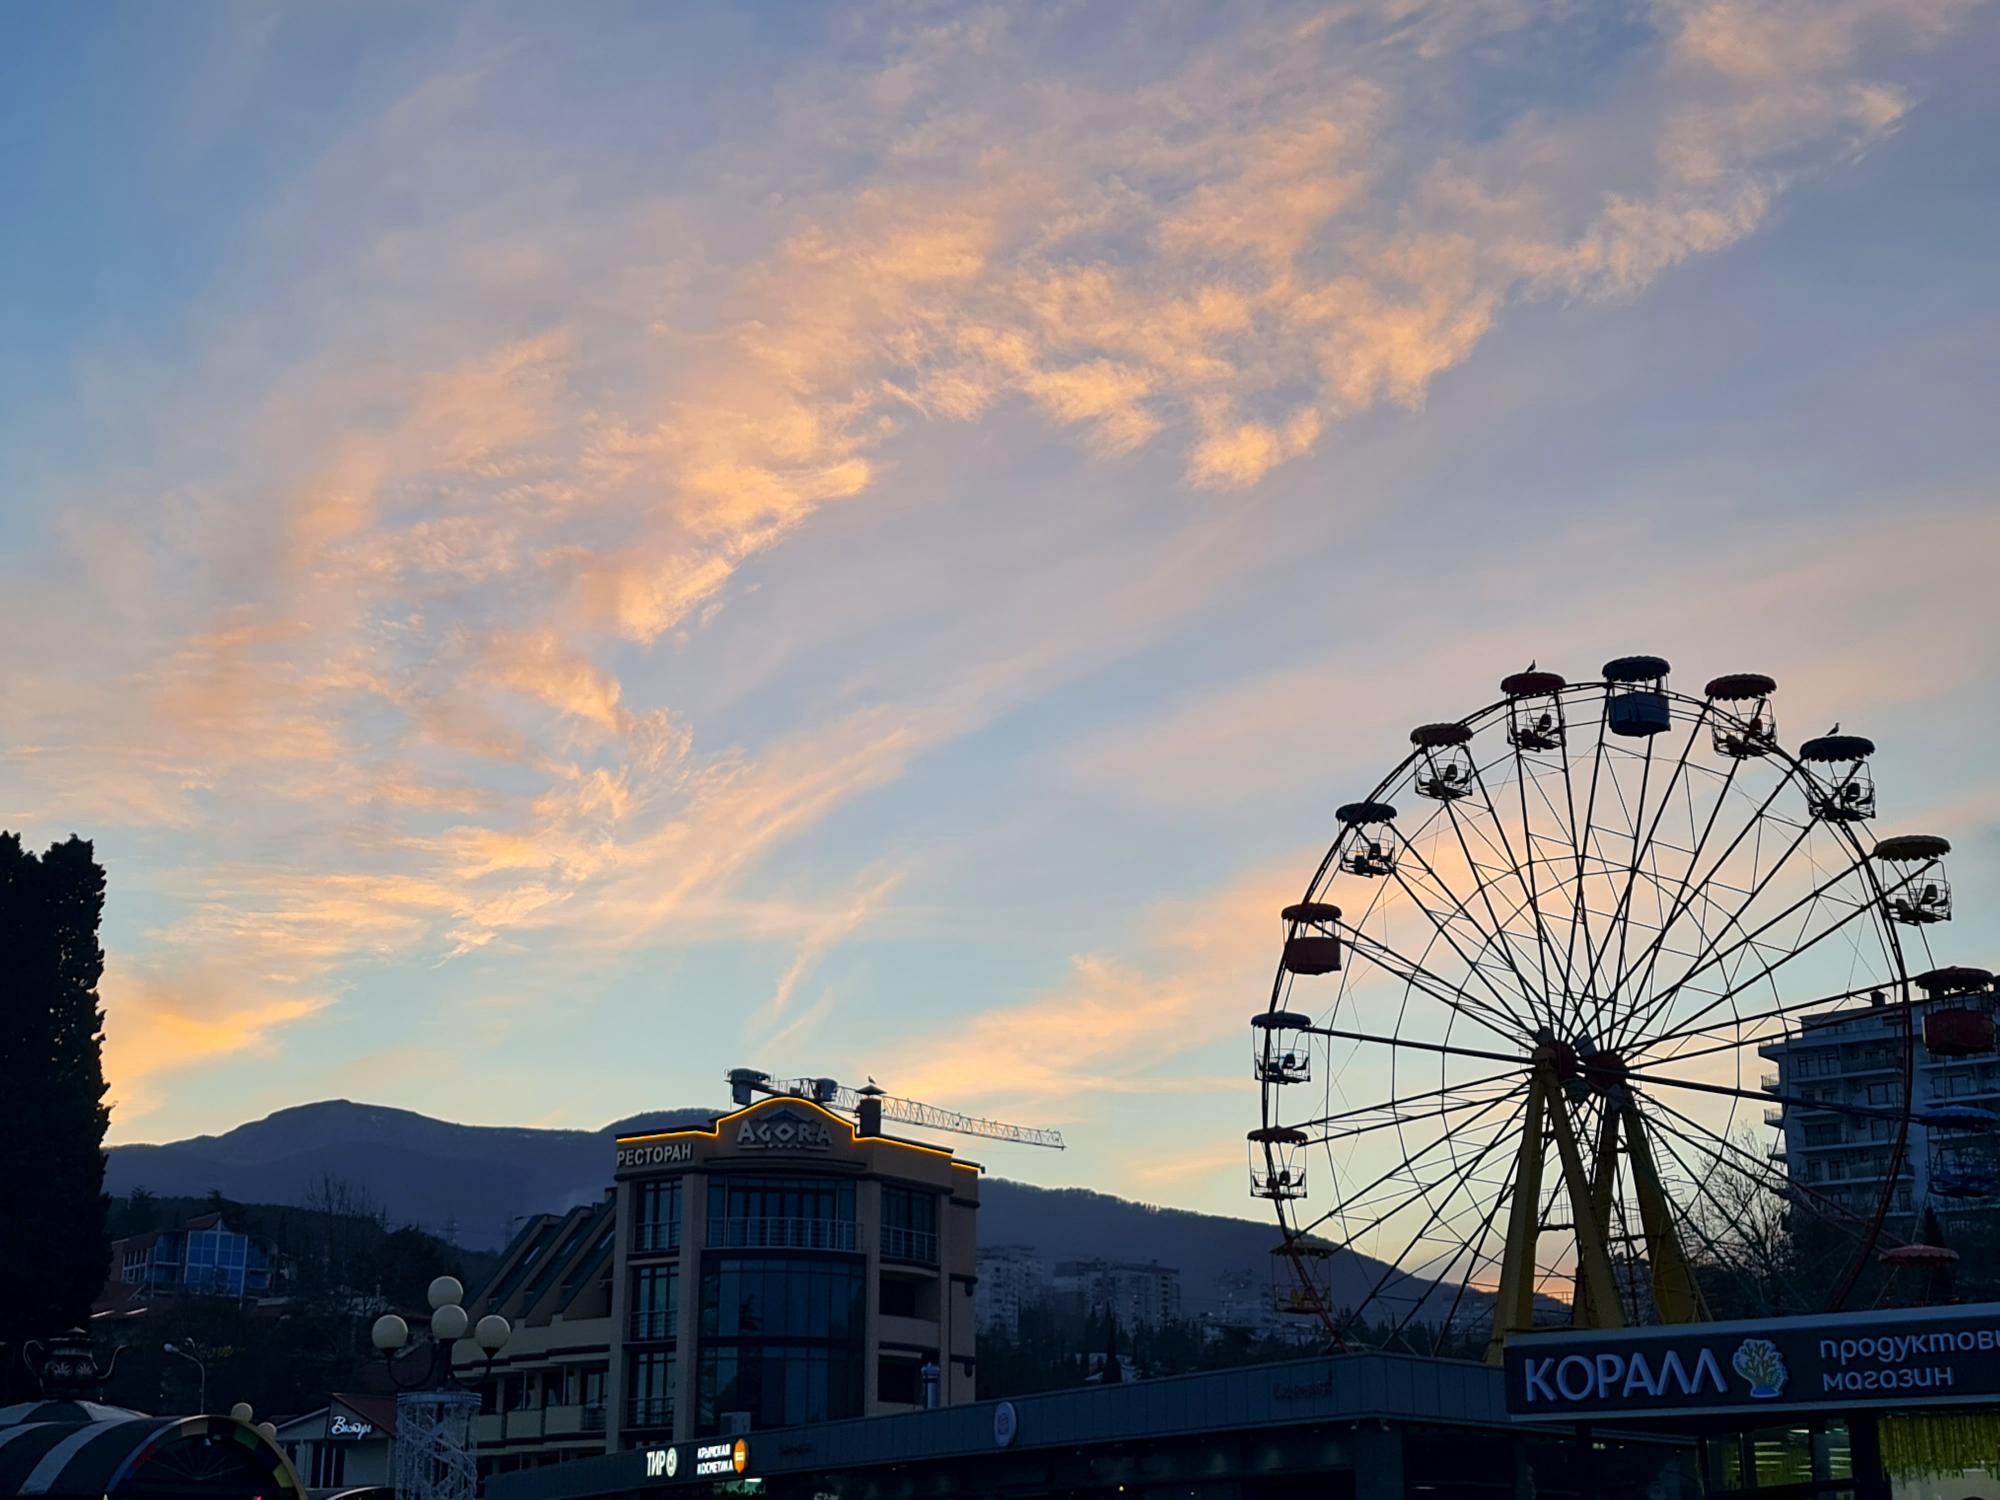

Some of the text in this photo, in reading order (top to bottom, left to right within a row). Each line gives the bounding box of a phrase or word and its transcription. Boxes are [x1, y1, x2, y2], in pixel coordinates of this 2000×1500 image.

[737, 1119, 832, 1143] AGORA
[616, 1143, 692, 1167] РЕСТОРАН
[1524, 1347, 1729, 1402] КОРАЛЛ
[1822, 1367, 1955, 1392] магазин
[697, 1459, 735, 1475] КОСМЕТИКА
